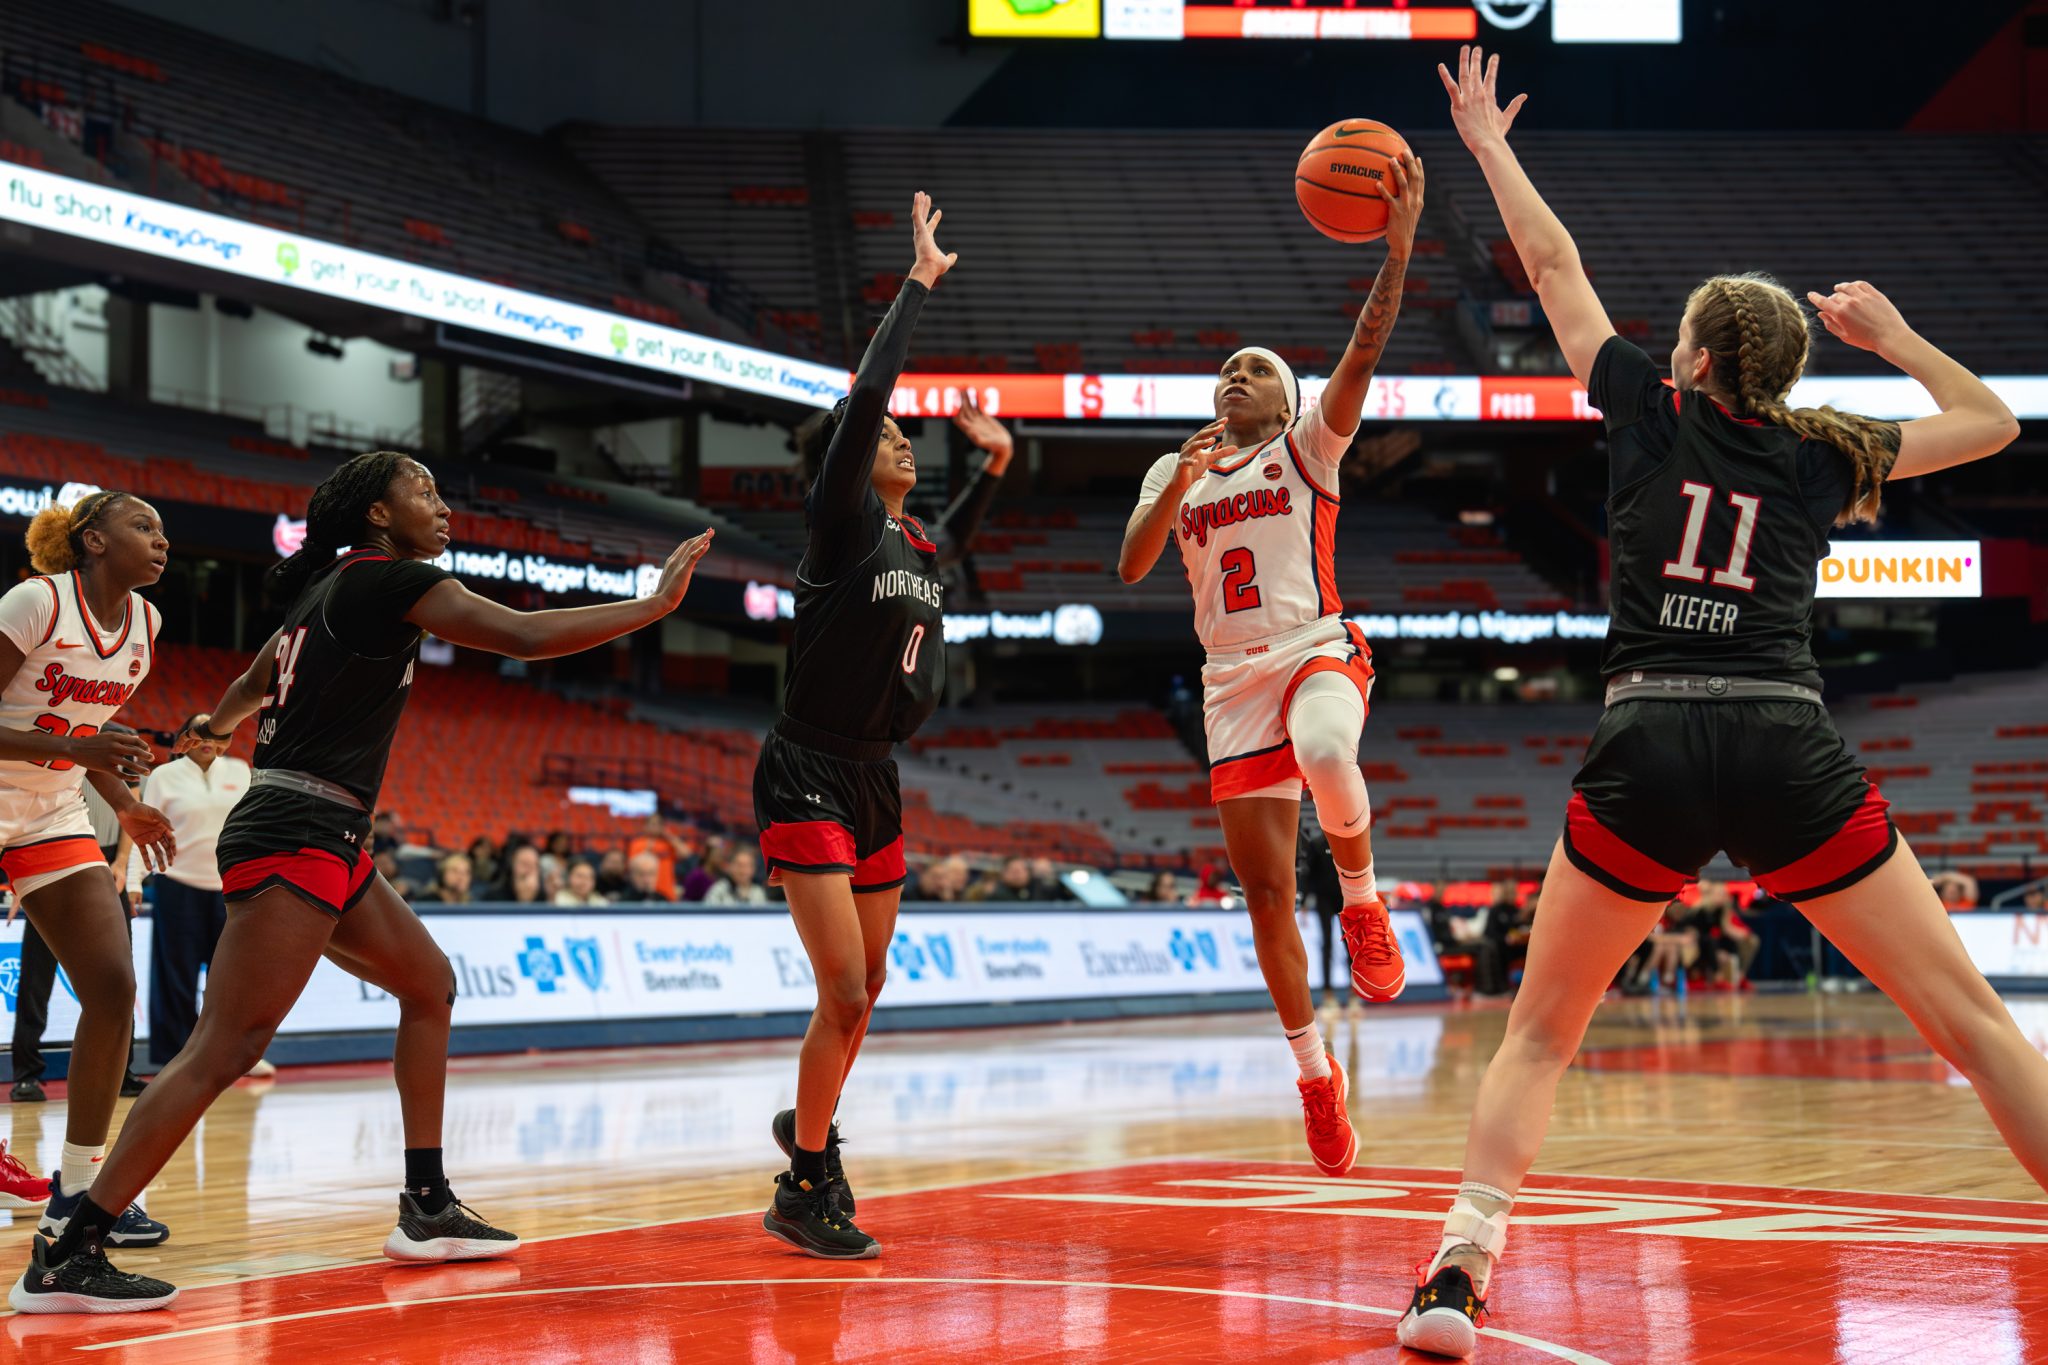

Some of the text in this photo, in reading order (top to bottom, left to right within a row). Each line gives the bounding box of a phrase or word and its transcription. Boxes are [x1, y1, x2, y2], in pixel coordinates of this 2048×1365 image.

[1330, 163, 1384, 180] SYRACUSE
[8, 178, 43, 209] flu
[54, 191, 113, 226] shot
[310, 259, 345, 281] get
[355, 270, 400, 292] your
[443, 288, 486, 313] shot
[636, 336, 664, 358] get
[670, 344, 707, 364] your
[713, 350, 733, 373] flu
[739, 360, 773, 382] shot
[1180, 486, 1293, 547] Syracuse
[1661, 479, 1762, 593] 11
[455, 551, 508, 580] need
[508, 558, 525, 582] a
[524, 554, 586, 594] bigger
[1220, 546, 1262, 614] 2
[1821, 556, 1972, 584] DUNKIN'
[1480, 609, 1555, 644] bigger
[1659, 592, 1739, 635] KIEFER
[1245, 644, 1270, 656] CUSE
[634, 939, 733, 965] Everybody
[1079, 940, 1172, 978] Excellus
[643, 969, 721, 992] Benefits
